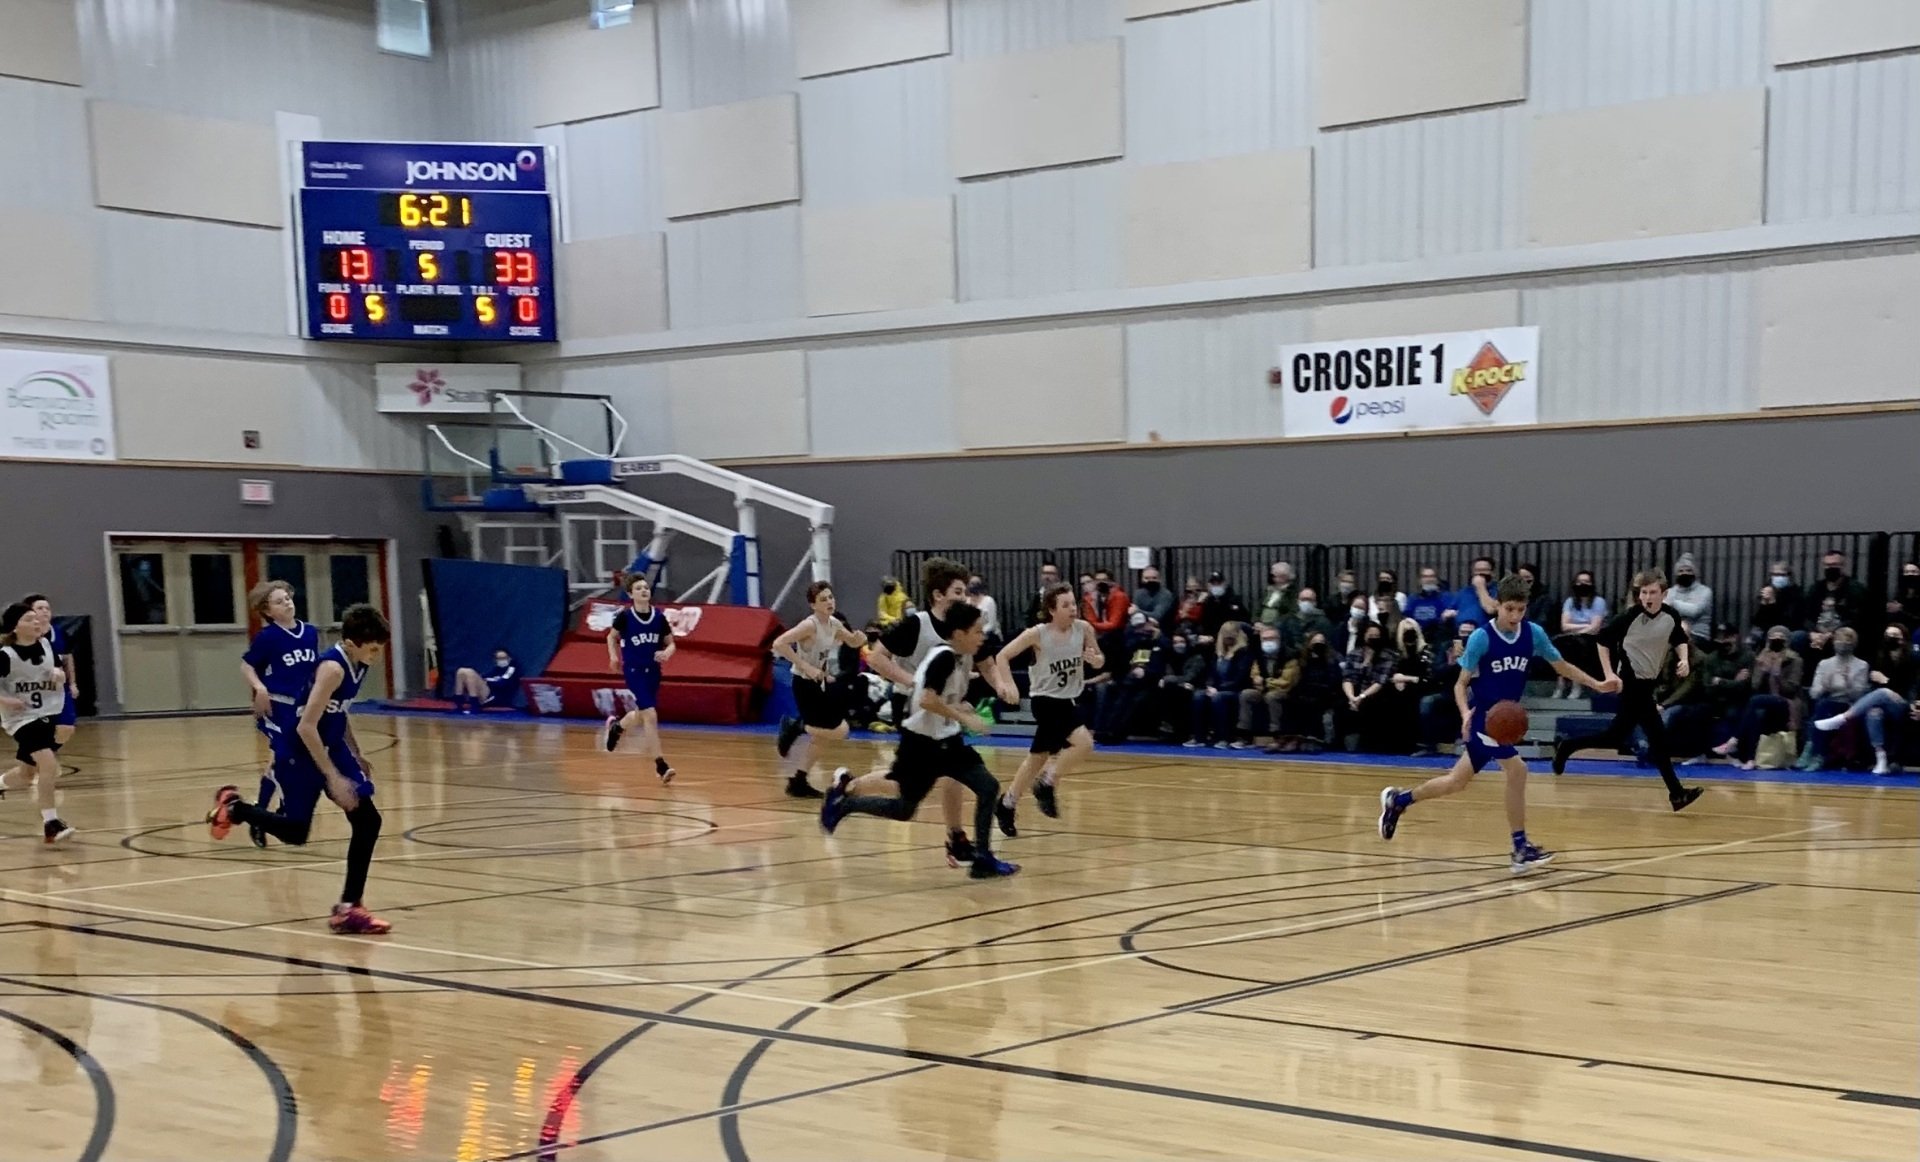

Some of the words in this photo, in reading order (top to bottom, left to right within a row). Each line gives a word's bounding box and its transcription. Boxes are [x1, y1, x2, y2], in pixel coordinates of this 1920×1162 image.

[405, 160, 517, 185] JOHNSON
[399, 194, 471, 227] 6:21
[322, 230, 366, 245] HOME
[485, 233, 533, 248] GUEST
[340, 249, 371, 280] 13
[418, 253, 438, 280] 5
[495, 251, 534, 283] 33
[329, 294, 347, 319] 0
[364, 294, 385, 321] 5
[475, 296, 495, 322] 5
[517, 297, 536, 322] 0
[1293, 345, 1423, 393] CROSBIE
[1429, 343, 1445, 384] 1
[1450, 361, 1528, 396] K-ROCK
[1355, 396, 1406, 419] pepsi
[631, 632, 659, 646] SPJH
[1491, 656, 1529, 673] SPJH
[30, 692, 43, 708] 9
